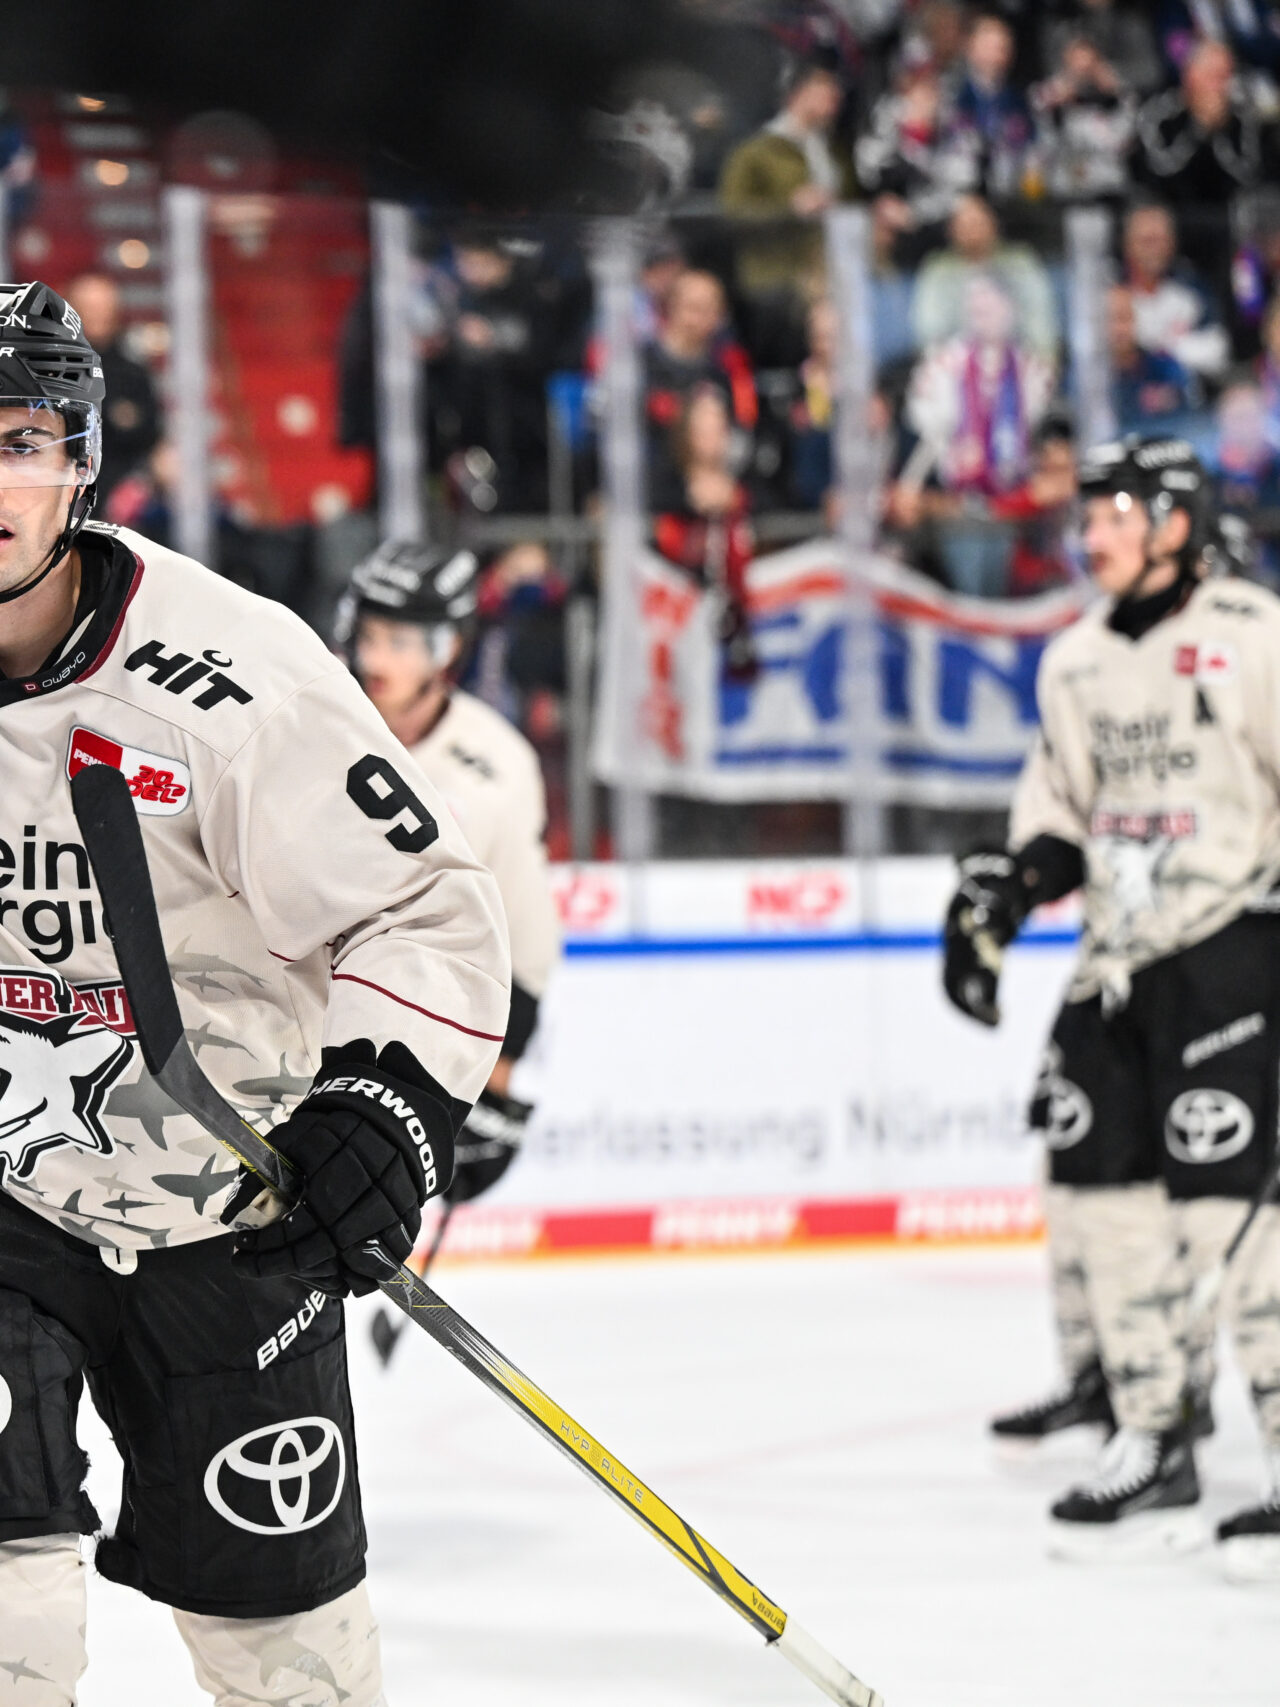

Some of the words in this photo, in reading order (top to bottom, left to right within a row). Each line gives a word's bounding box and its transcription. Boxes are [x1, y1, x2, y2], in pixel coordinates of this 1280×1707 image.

[123, 640, 254, 712] HIT
[346, 753, 439, 854] 9
[306, 1076, 438, 1195] HERWOOD
[256, 1289, 327, 1371] BAUE
